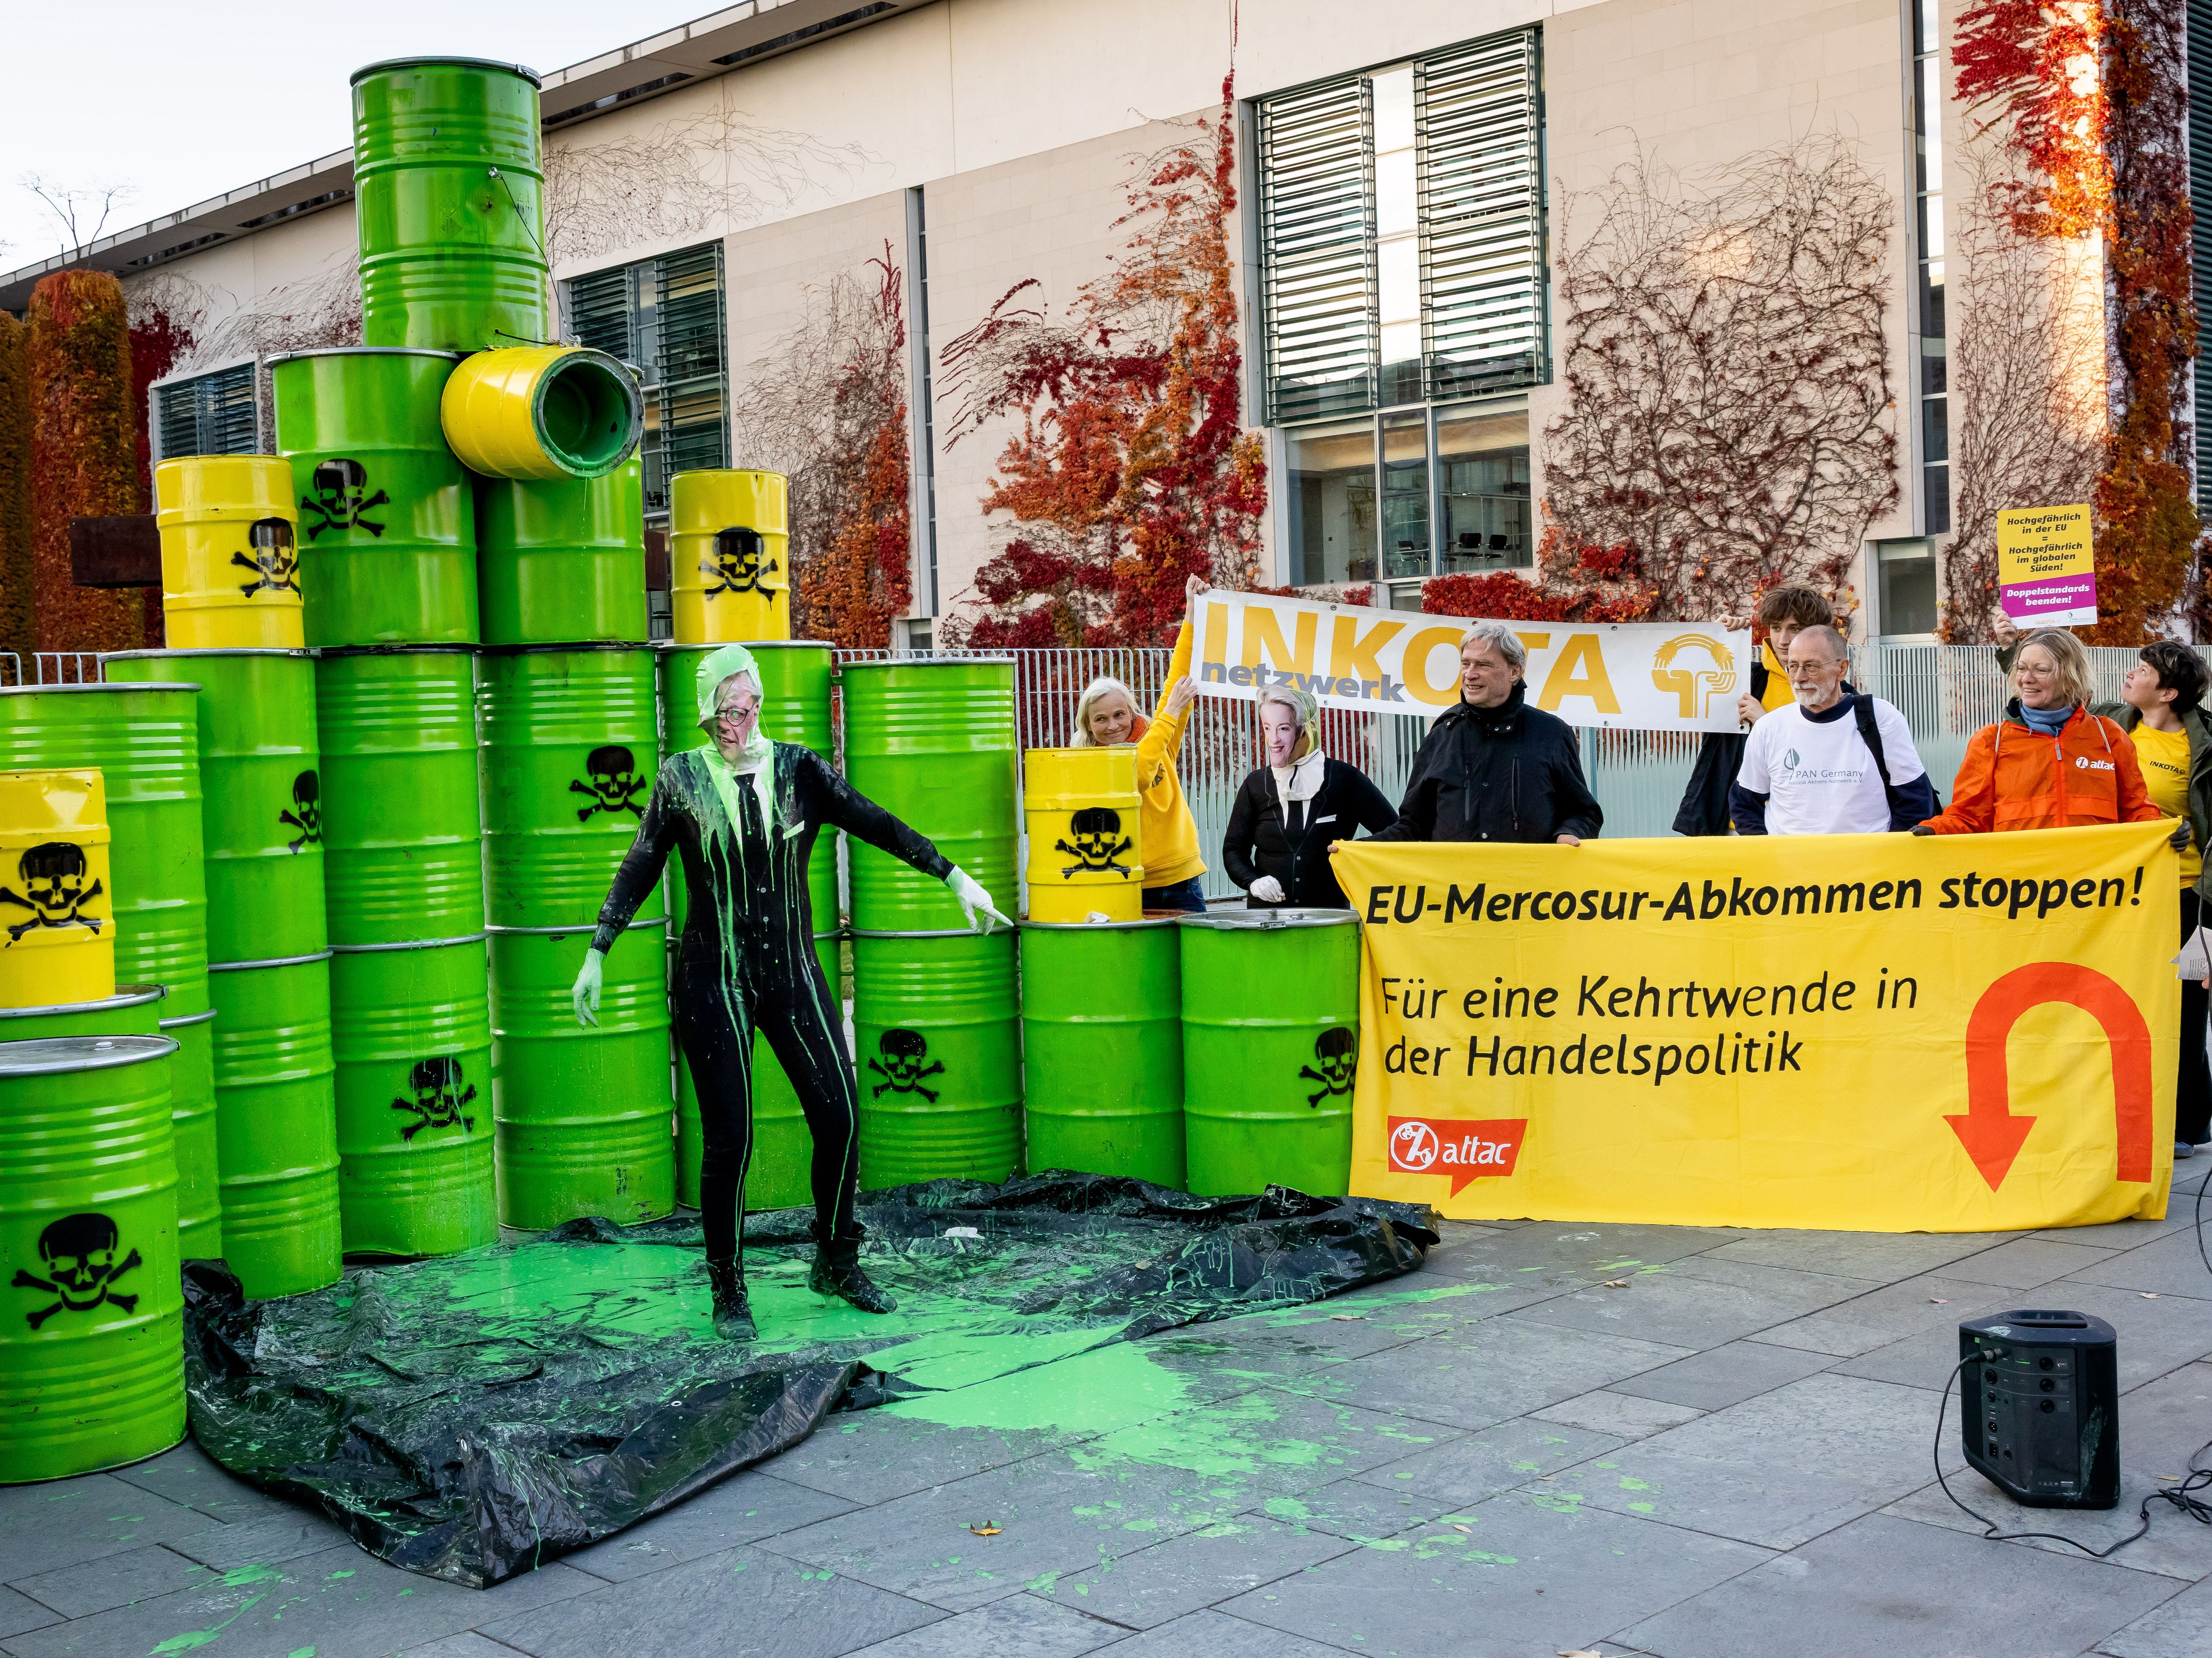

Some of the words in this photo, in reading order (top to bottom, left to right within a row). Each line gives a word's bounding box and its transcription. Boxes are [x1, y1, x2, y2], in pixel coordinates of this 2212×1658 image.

[2007, 513, 2081, 525] Hochgefährlich
[2009, 542, 2082, 554] Hochgefährlich
[2033, 553, 2075, 564] globalen
[2030, 563, 2063, 572] Süden!
[2007, 584, 2089, 597] Doppelstandards
[2025, 596, 2072, 606] beenden!
[1201, 661, 1406, 702] netzwerk
[2150, 760, 2179, 774] INKOTA
[1796, 770, 1817, 778] PAN
[1821, 770, 1863, 778] Germany
[1366, 877, 1921, 924] EU-Mercosur-Abkommen
[1938, 866, 2144, 920] stoppen!
[1381, 977, 1448, 1019] Für
[1463, 977, 1559, 1018] eine
[1577, 970, 1856, 1018] Kehrtwende
[1877, 967, 1917, 1009] in
[1385, 1035, 1451, 1076] der
[1467, 1031, 1803, 1087] Handelspolitik
[1442, 1135, 1512, 1164] attac
